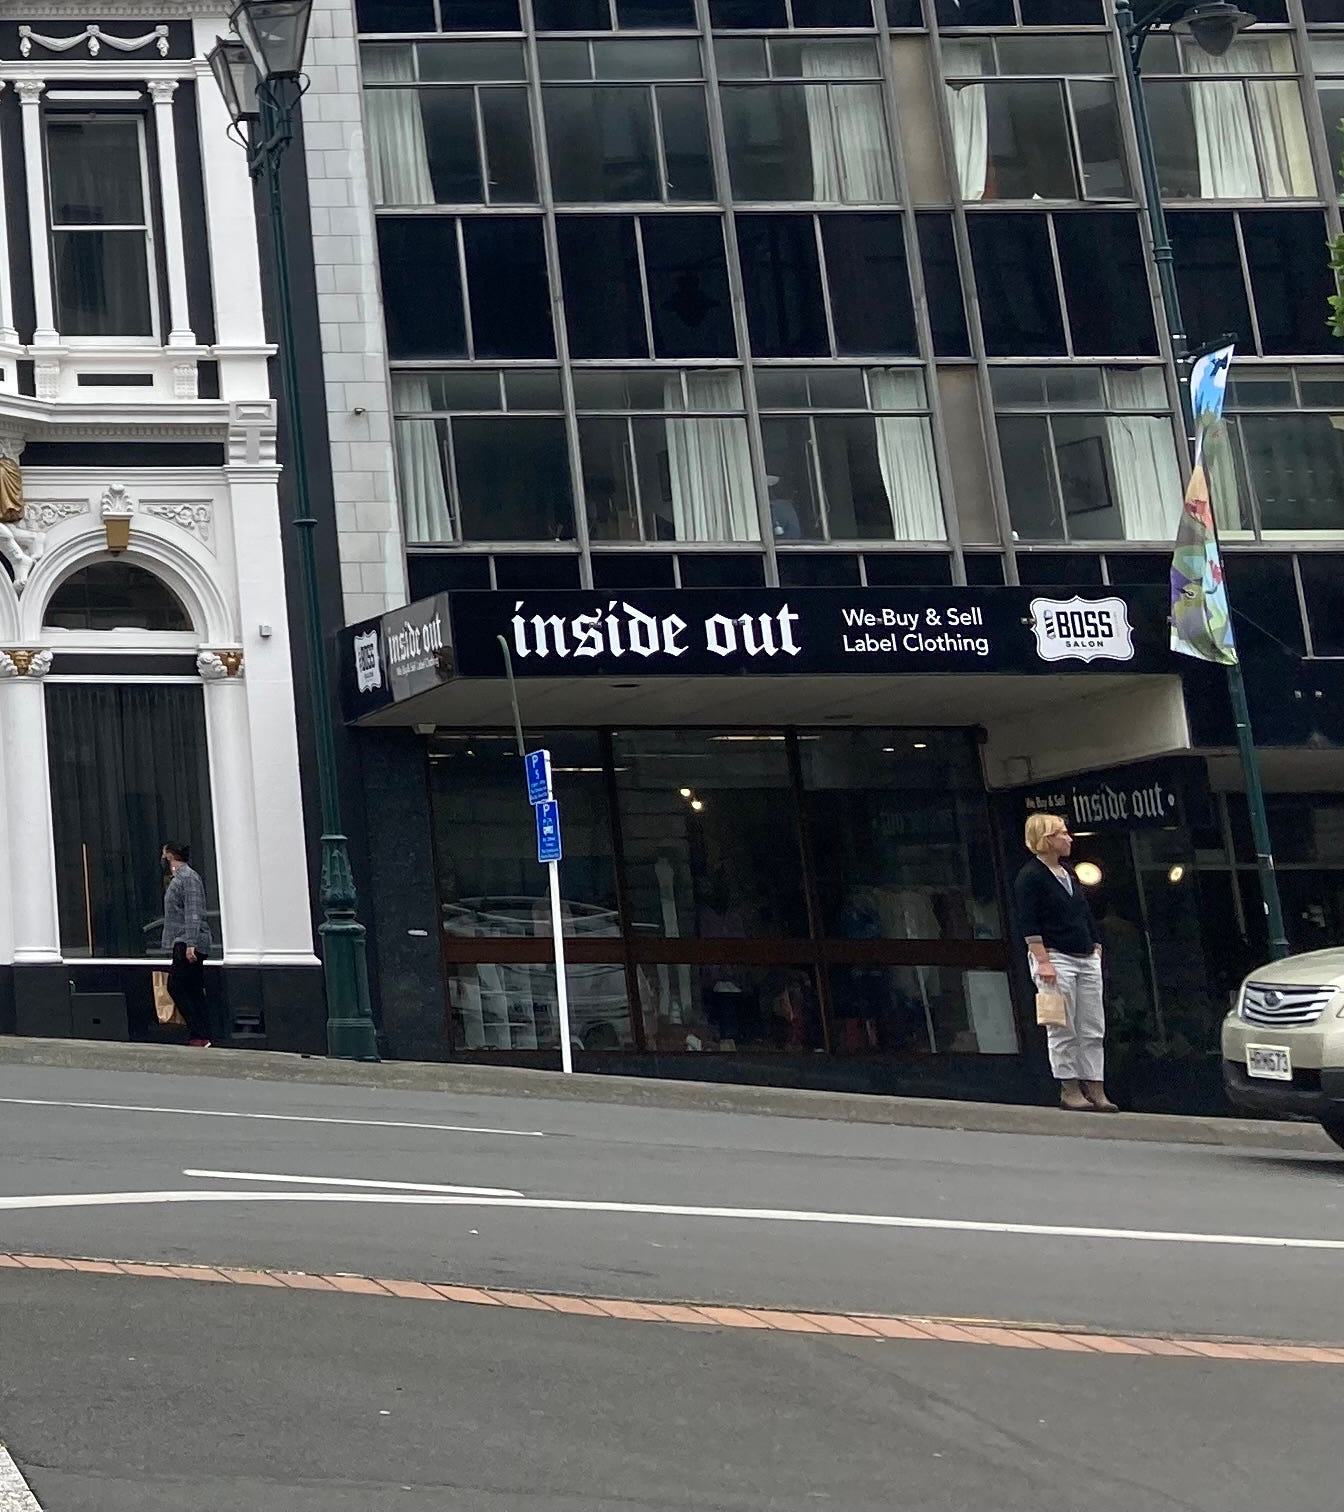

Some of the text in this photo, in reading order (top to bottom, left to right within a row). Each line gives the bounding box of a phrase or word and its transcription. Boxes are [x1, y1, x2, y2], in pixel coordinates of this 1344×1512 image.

[511, 600, 802, 657] inside out
[842, 607, 983, 630] We Buy & Sell
[1055, 611, 1114, 638] BOSS
[387, 611, 443, 664] inside out
[842, 633, 989, 656] Label Clothing
[1065, 640, 1104, 648] SALON
[532, 755, 539, 768] P
[543, 804, 550, 817] P
[1073, 782, 1164, 823] inside out
